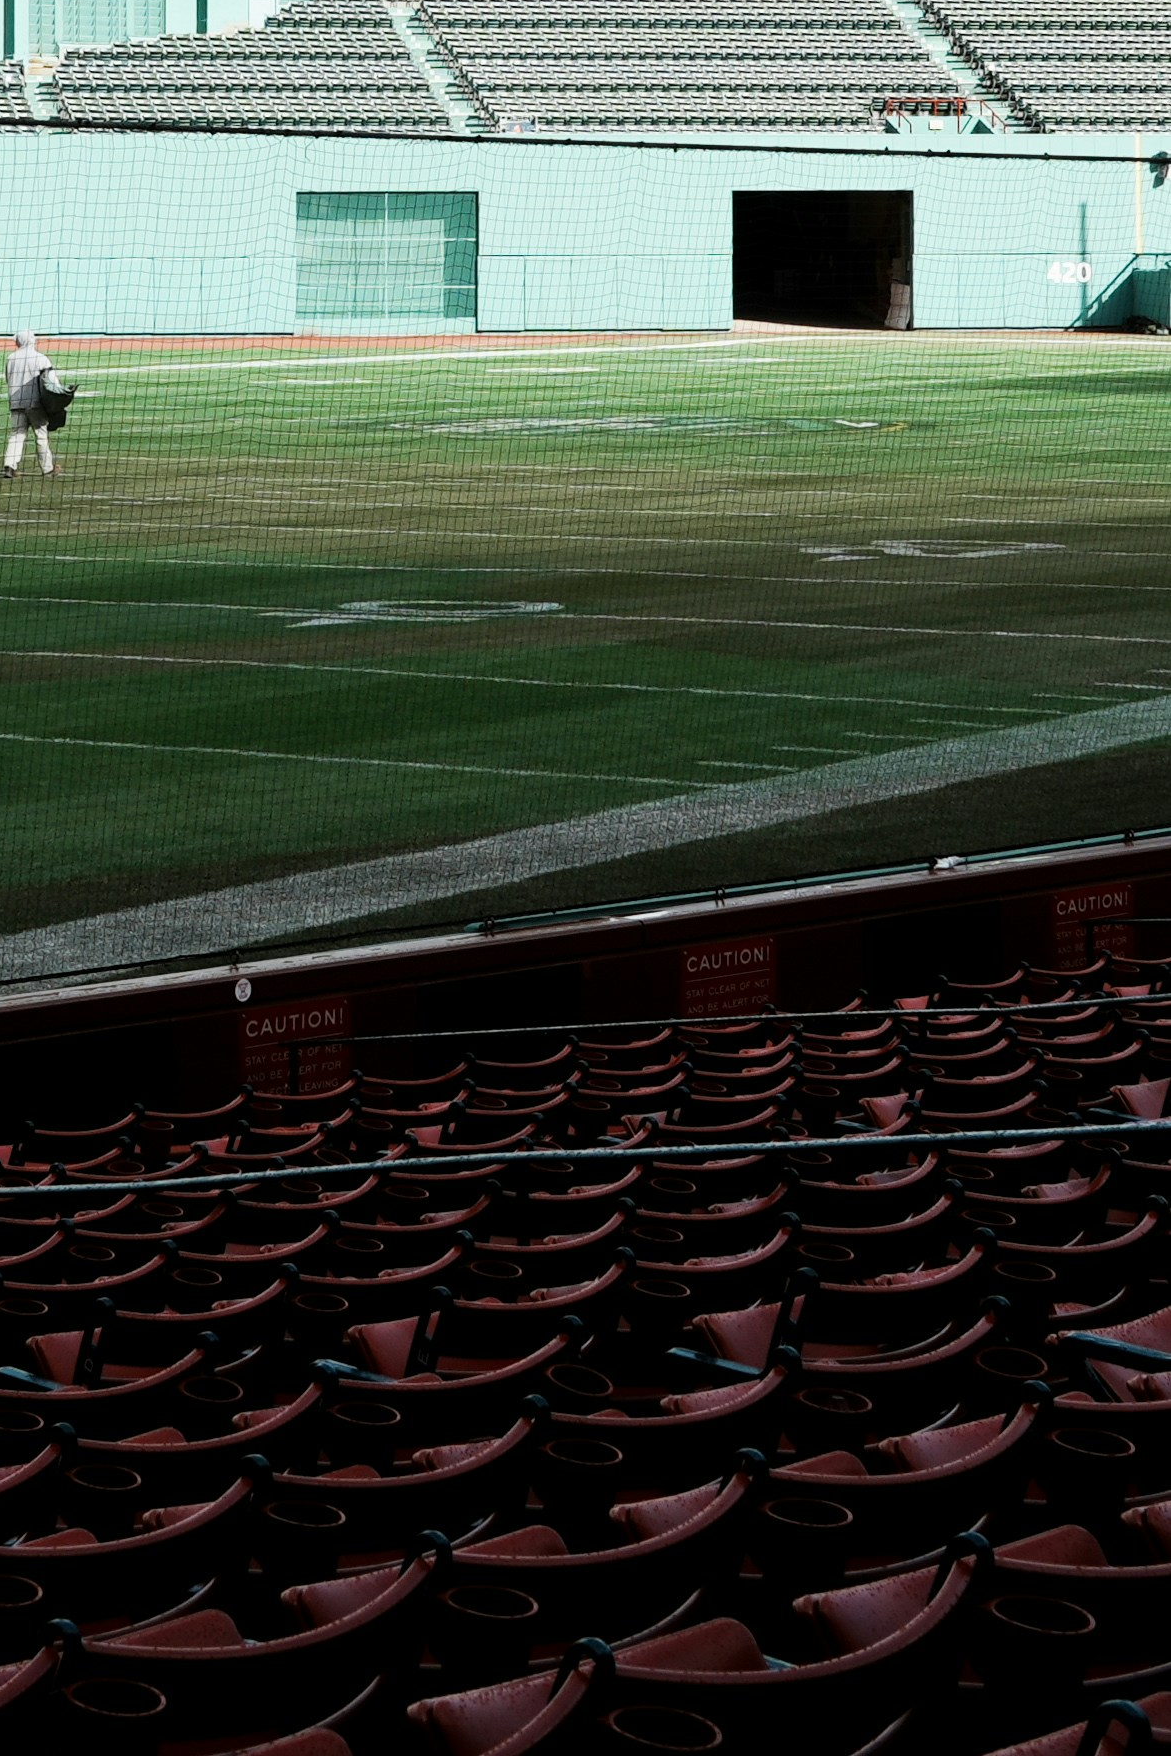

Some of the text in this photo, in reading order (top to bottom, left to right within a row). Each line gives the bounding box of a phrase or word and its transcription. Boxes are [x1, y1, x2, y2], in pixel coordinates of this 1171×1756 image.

[1047, 260, 1092, 284] 420
[1056, 891, 1128, 916] CAUTION!
[686, 945, 770, 972] CAUTION!
[245, 1007, 343, 1037] CAUTION!
[245, 1055, 267, 1067] STAY
[271, 1049, 303, 1062] CLER
[307, 1045, 321, 1057] OF
[246, 1072, 266, 1084] AND
[270, 1069, 283, 1080] BE
[322, 1060, 342, 1072] FOR
[299, 1077, 339, 1093] LEAVING
